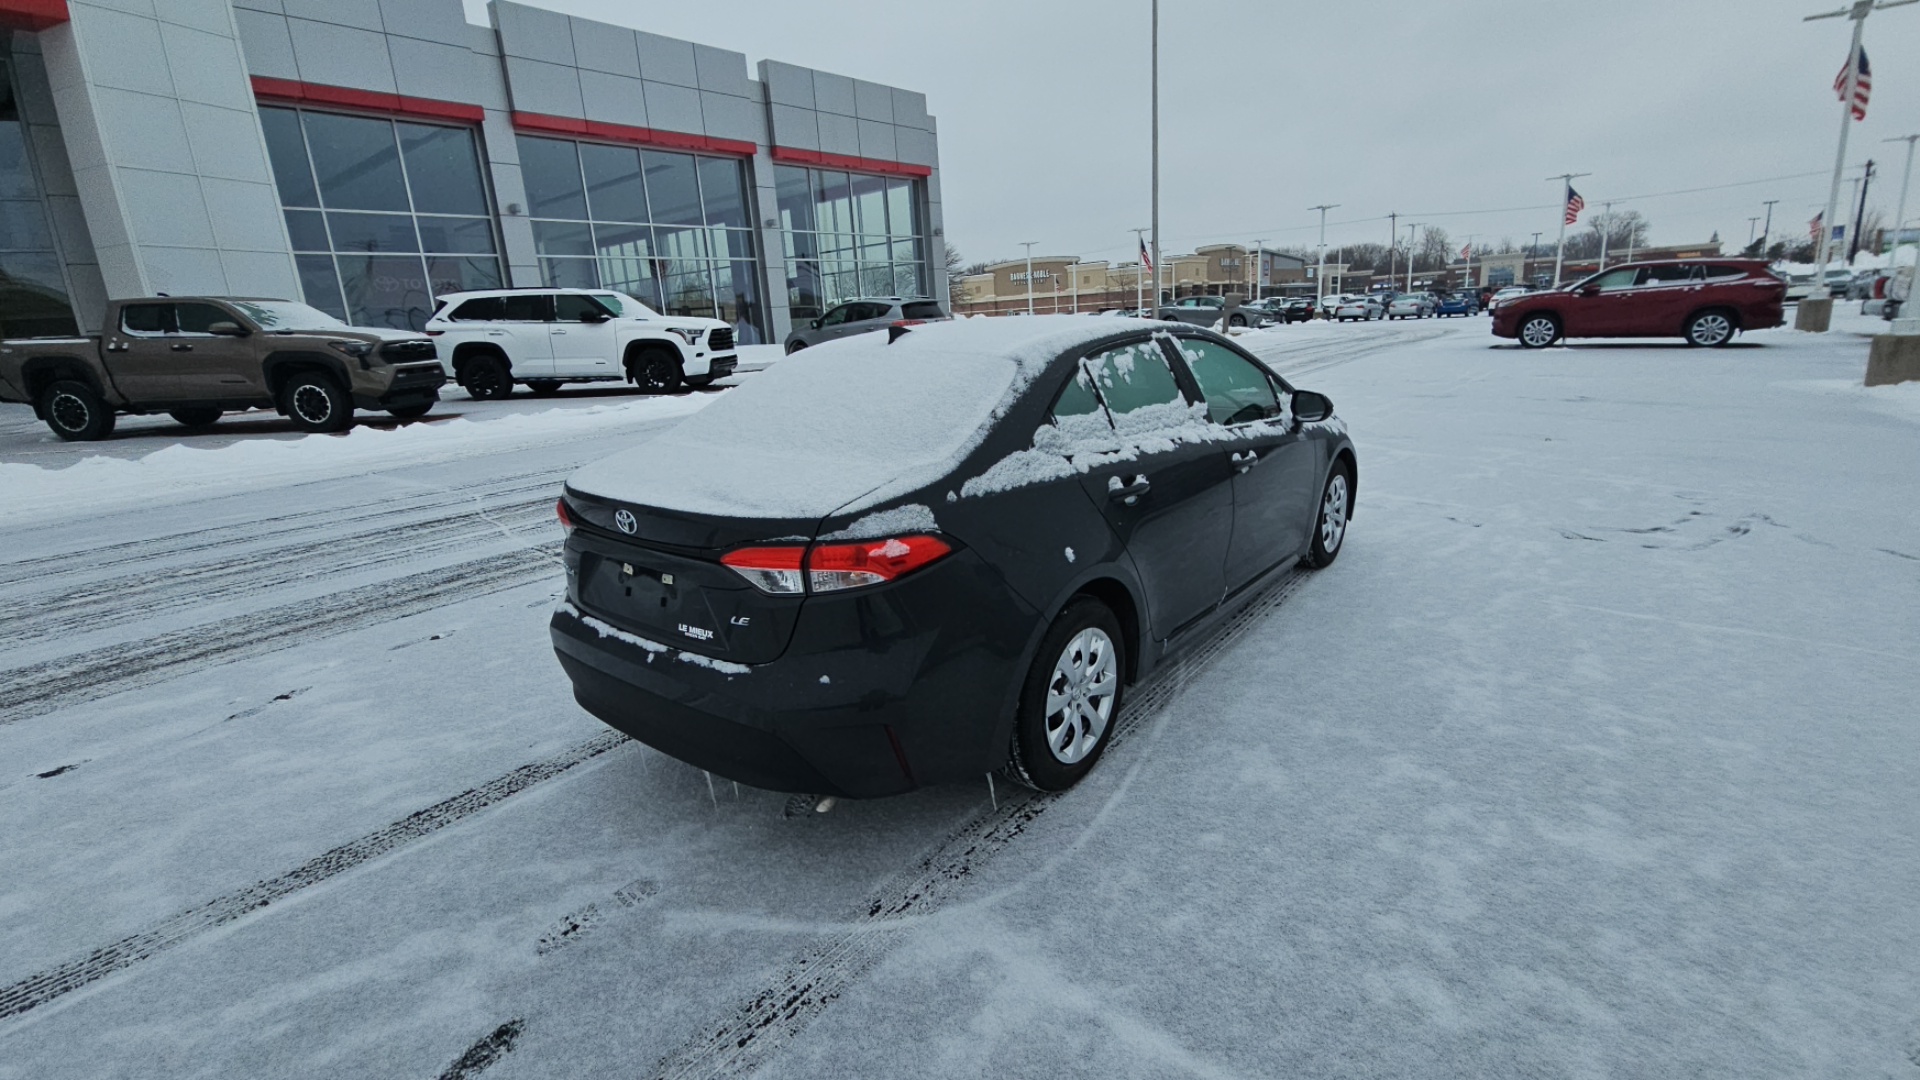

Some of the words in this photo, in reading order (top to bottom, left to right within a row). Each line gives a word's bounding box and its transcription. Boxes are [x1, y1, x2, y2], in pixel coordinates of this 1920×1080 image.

[730, 616, 751, 626] LE
[678, 623, 688, 632] LE
[689, 626, 714, 639] MIEUX
